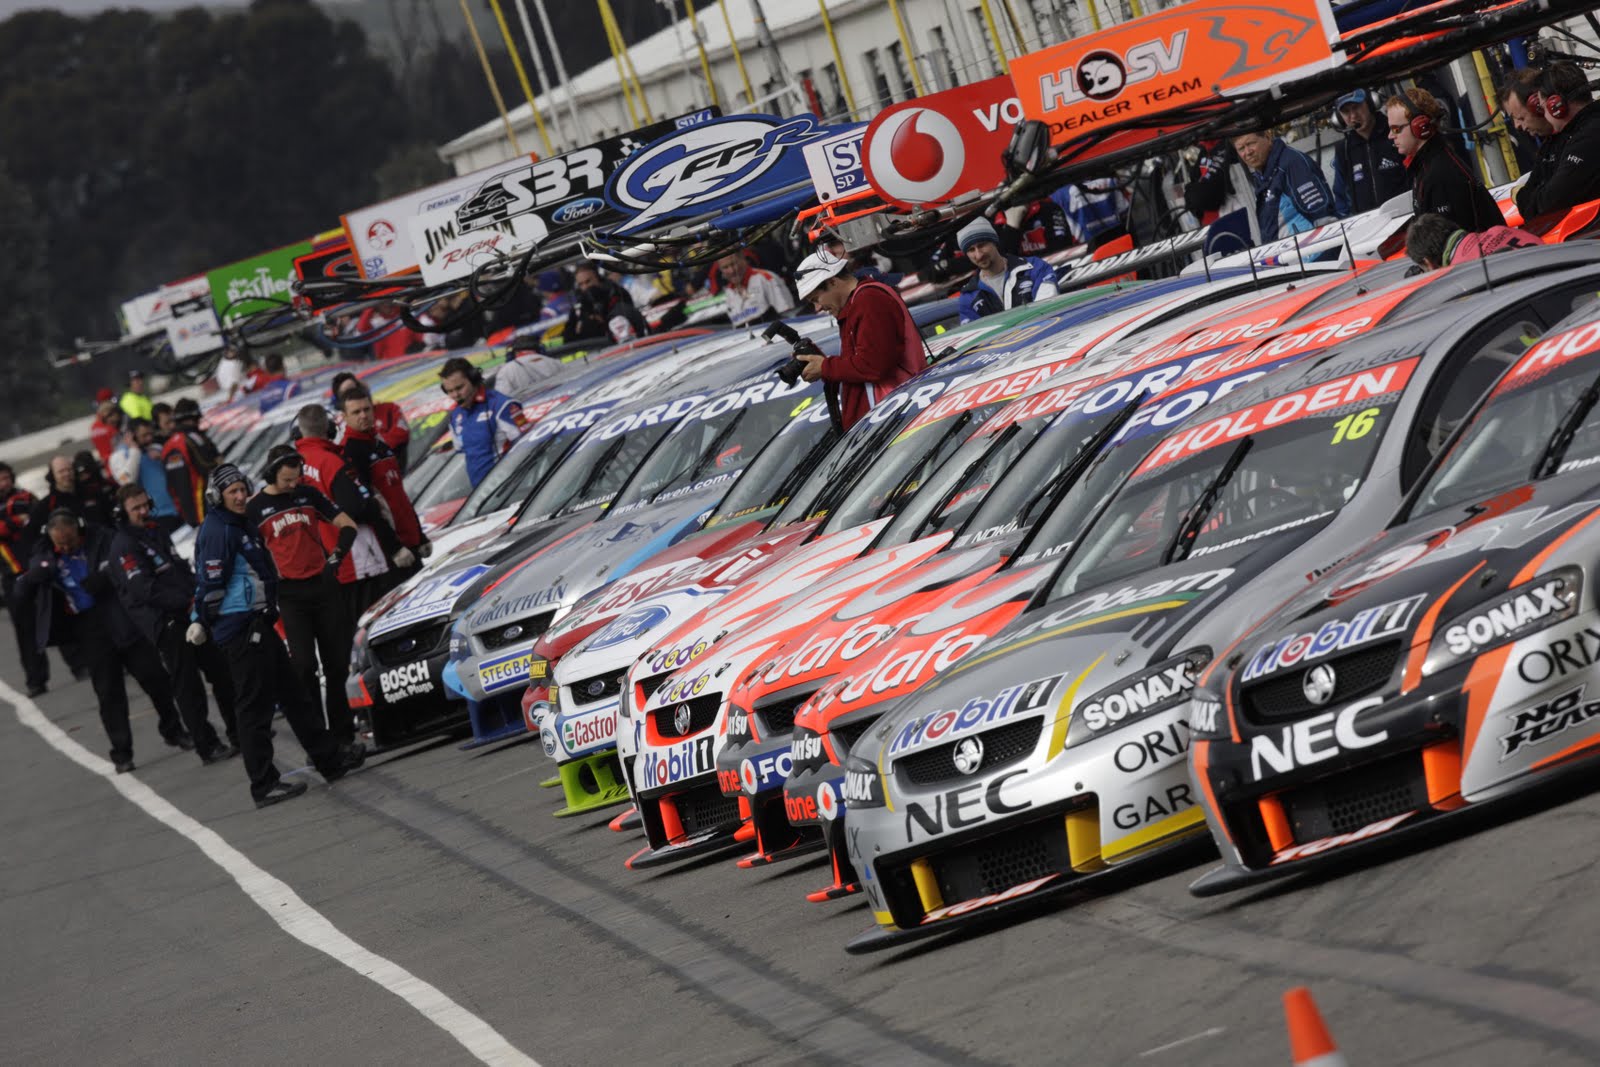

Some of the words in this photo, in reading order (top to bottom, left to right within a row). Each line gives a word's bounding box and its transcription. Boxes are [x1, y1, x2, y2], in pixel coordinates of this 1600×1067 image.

[1051, 99, 1131, 136] DEALER
[1138, 76, 1203, 106] TEAM
[501, 147, 604, 215] SBR
[1567, 154, 1584, 164] HRT
[561, 205, 596, 221] Ford
[424, 220, 456, 265] JIM
[442, 234, 503, 270] Racing
[576, 395, 706, 453] FORD
[910, 362, 1068, 430] HOLDEN
[972, 380, 1100, 434] HOLDE
[1146, 366, 1397, 468] HOLDEN
[1331, 408, 1380, 445] 16
[1240, 607, 1378, 683] Mobil
[1443, 579, 1566, 656] SONAX
[379, 659, 430, 693] BOSCH
[384, 685, 409, 704] Spark
[407, 681, 434, 696] Plugs
[1083, 663, 1200, 731] SONAX
[574, 711, 618, 747] Castrol
[889, 682, 1025, 754] Mobil
[1250, 696, 1388, 781] NEC
[643, 747, 695, 789] Mobil
[904, 768, 1033, 843] NEC
[1112, 783, 1196, 830] GAR
